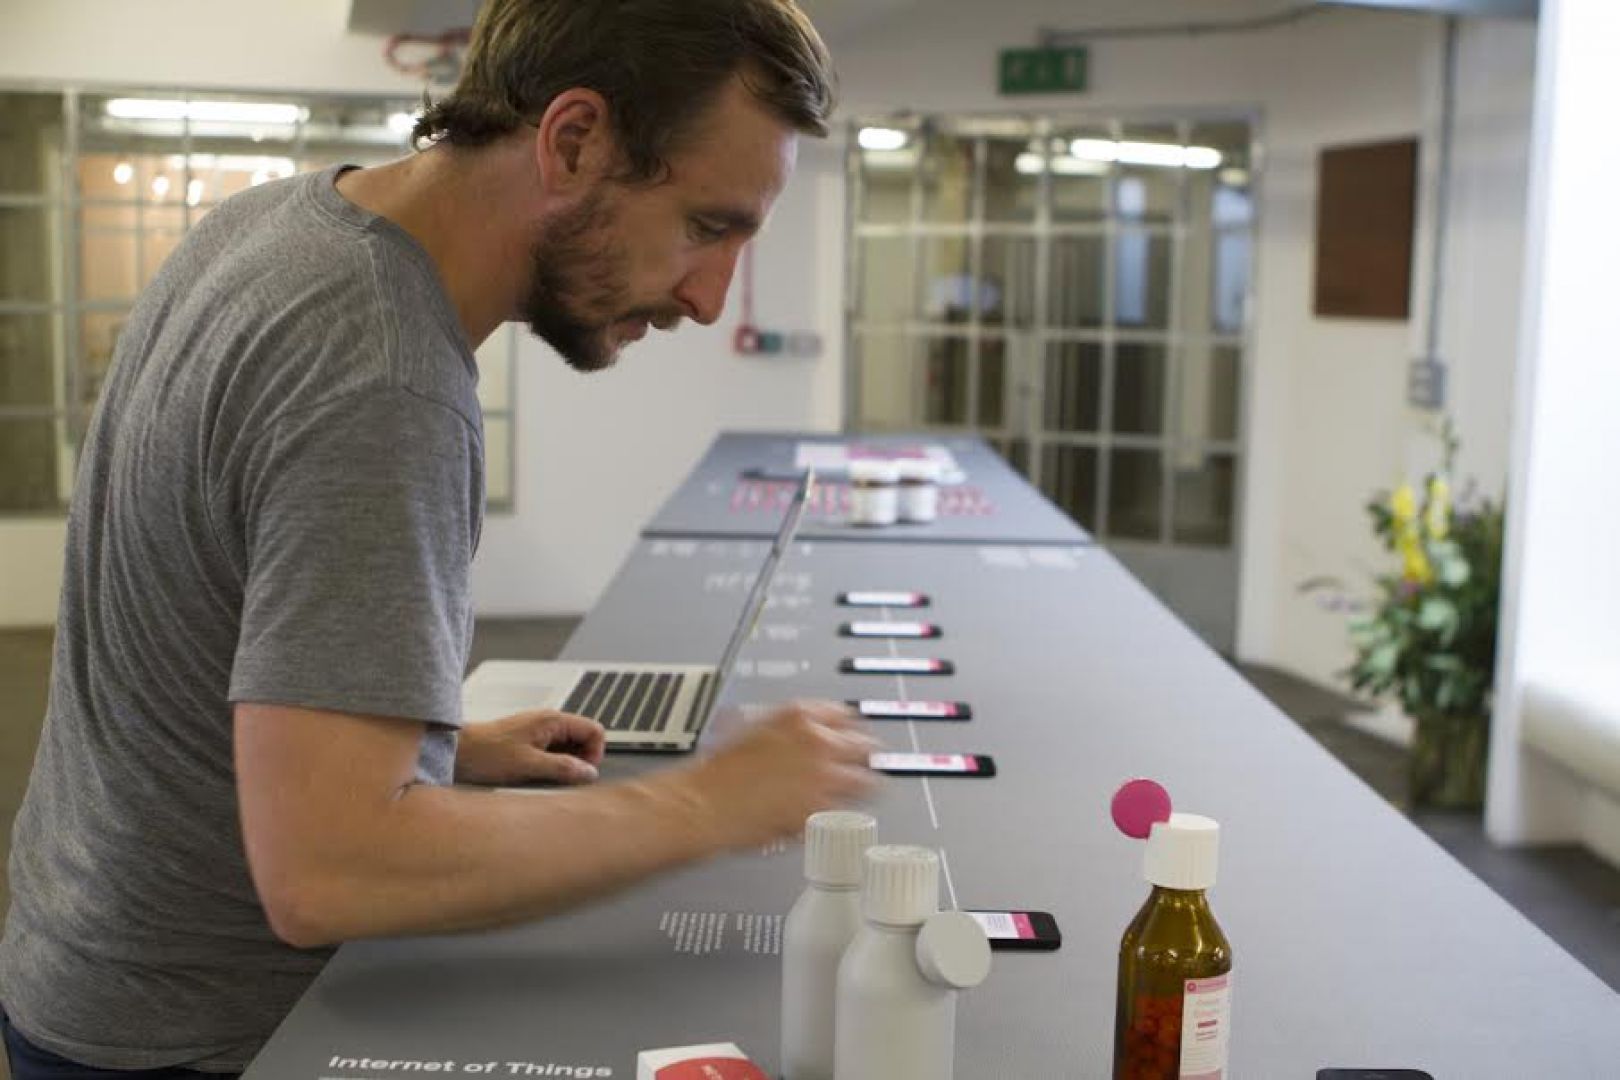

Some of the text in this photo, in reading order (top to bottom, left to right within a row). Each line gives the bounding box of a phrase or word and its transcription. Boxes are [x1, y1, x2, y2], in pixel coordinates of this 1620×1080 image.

[329, 1055, 613, 1078] Internet of Things
